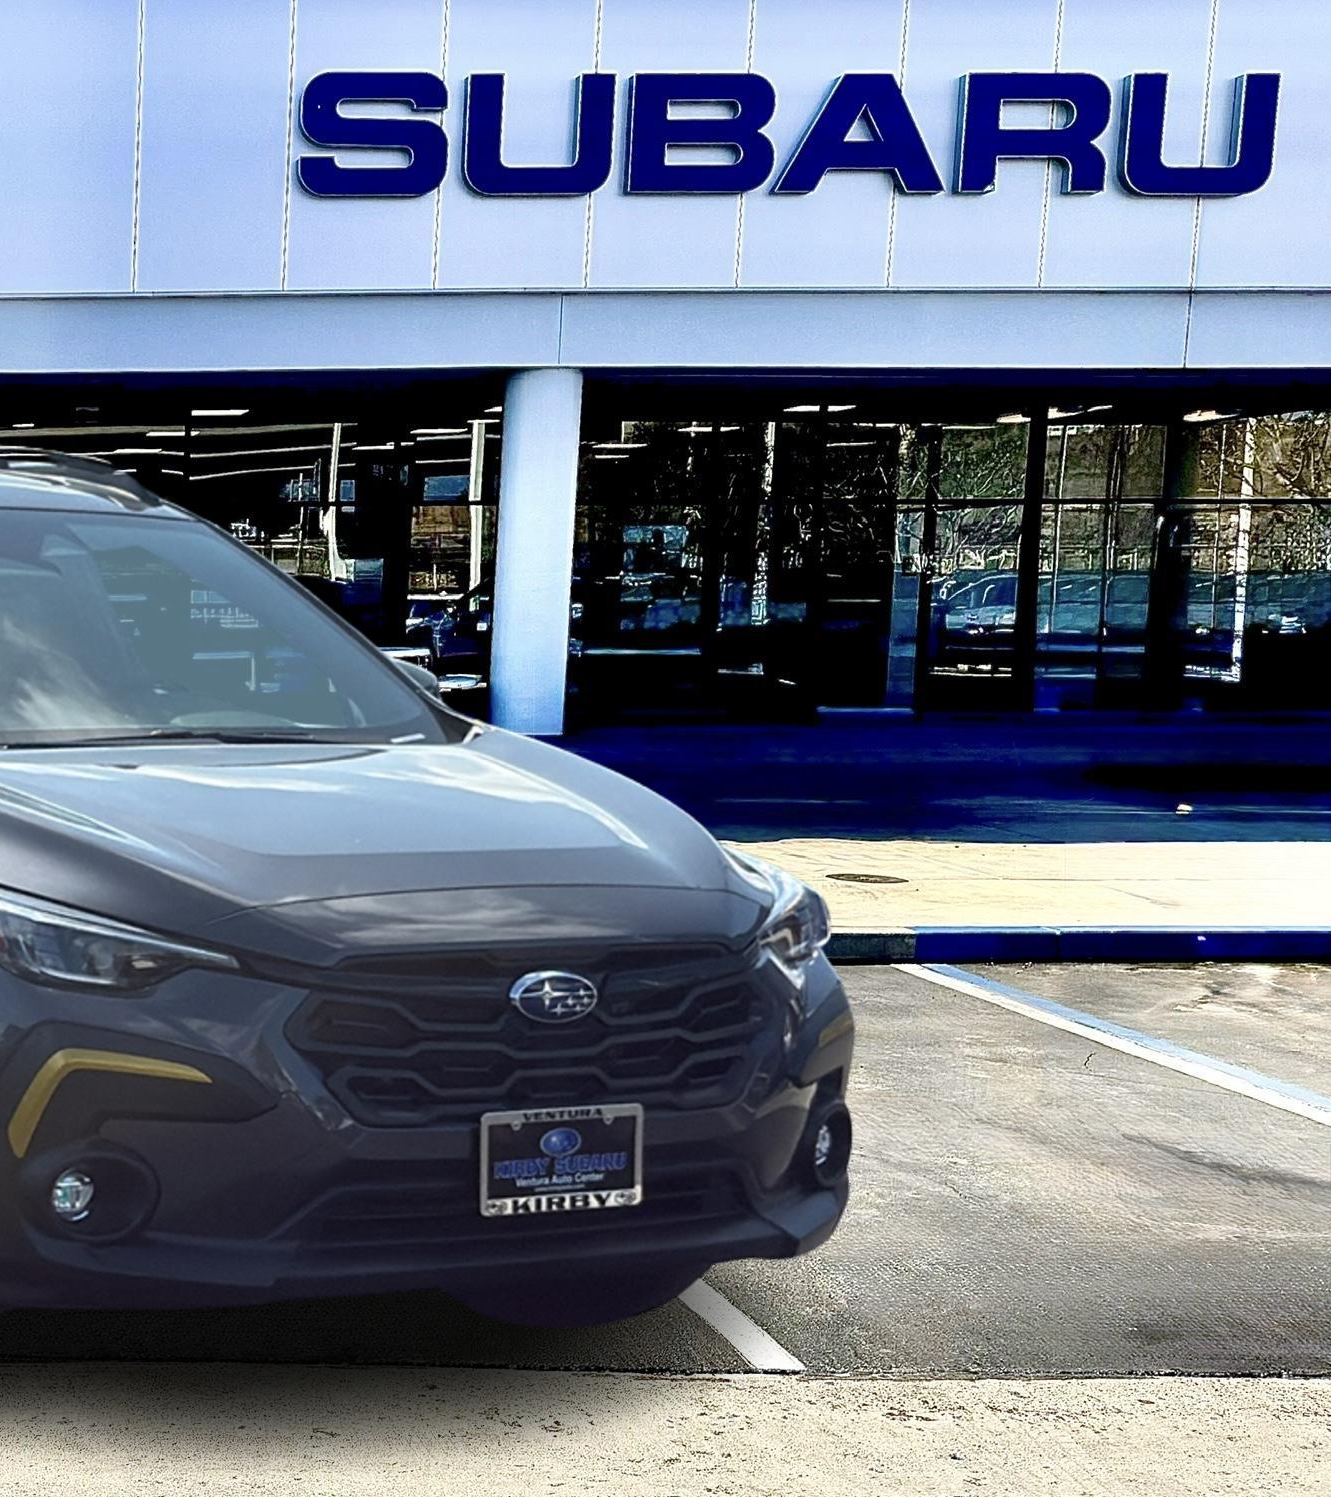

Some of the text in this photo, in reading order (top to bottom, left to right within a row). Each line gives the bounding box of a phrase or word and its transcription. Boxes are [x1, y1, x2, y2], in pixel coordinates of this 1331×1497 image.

[296, 71, 1281, 198] SUBARU
[522, 1108, 603, 1121] VENTURA
[495, 1153, 627, 1178] KIRBY SUBARU
[515, 1171, 604, 1187] Ventura Auto Center
[512, 1193, 611, 1214] KIRBY
